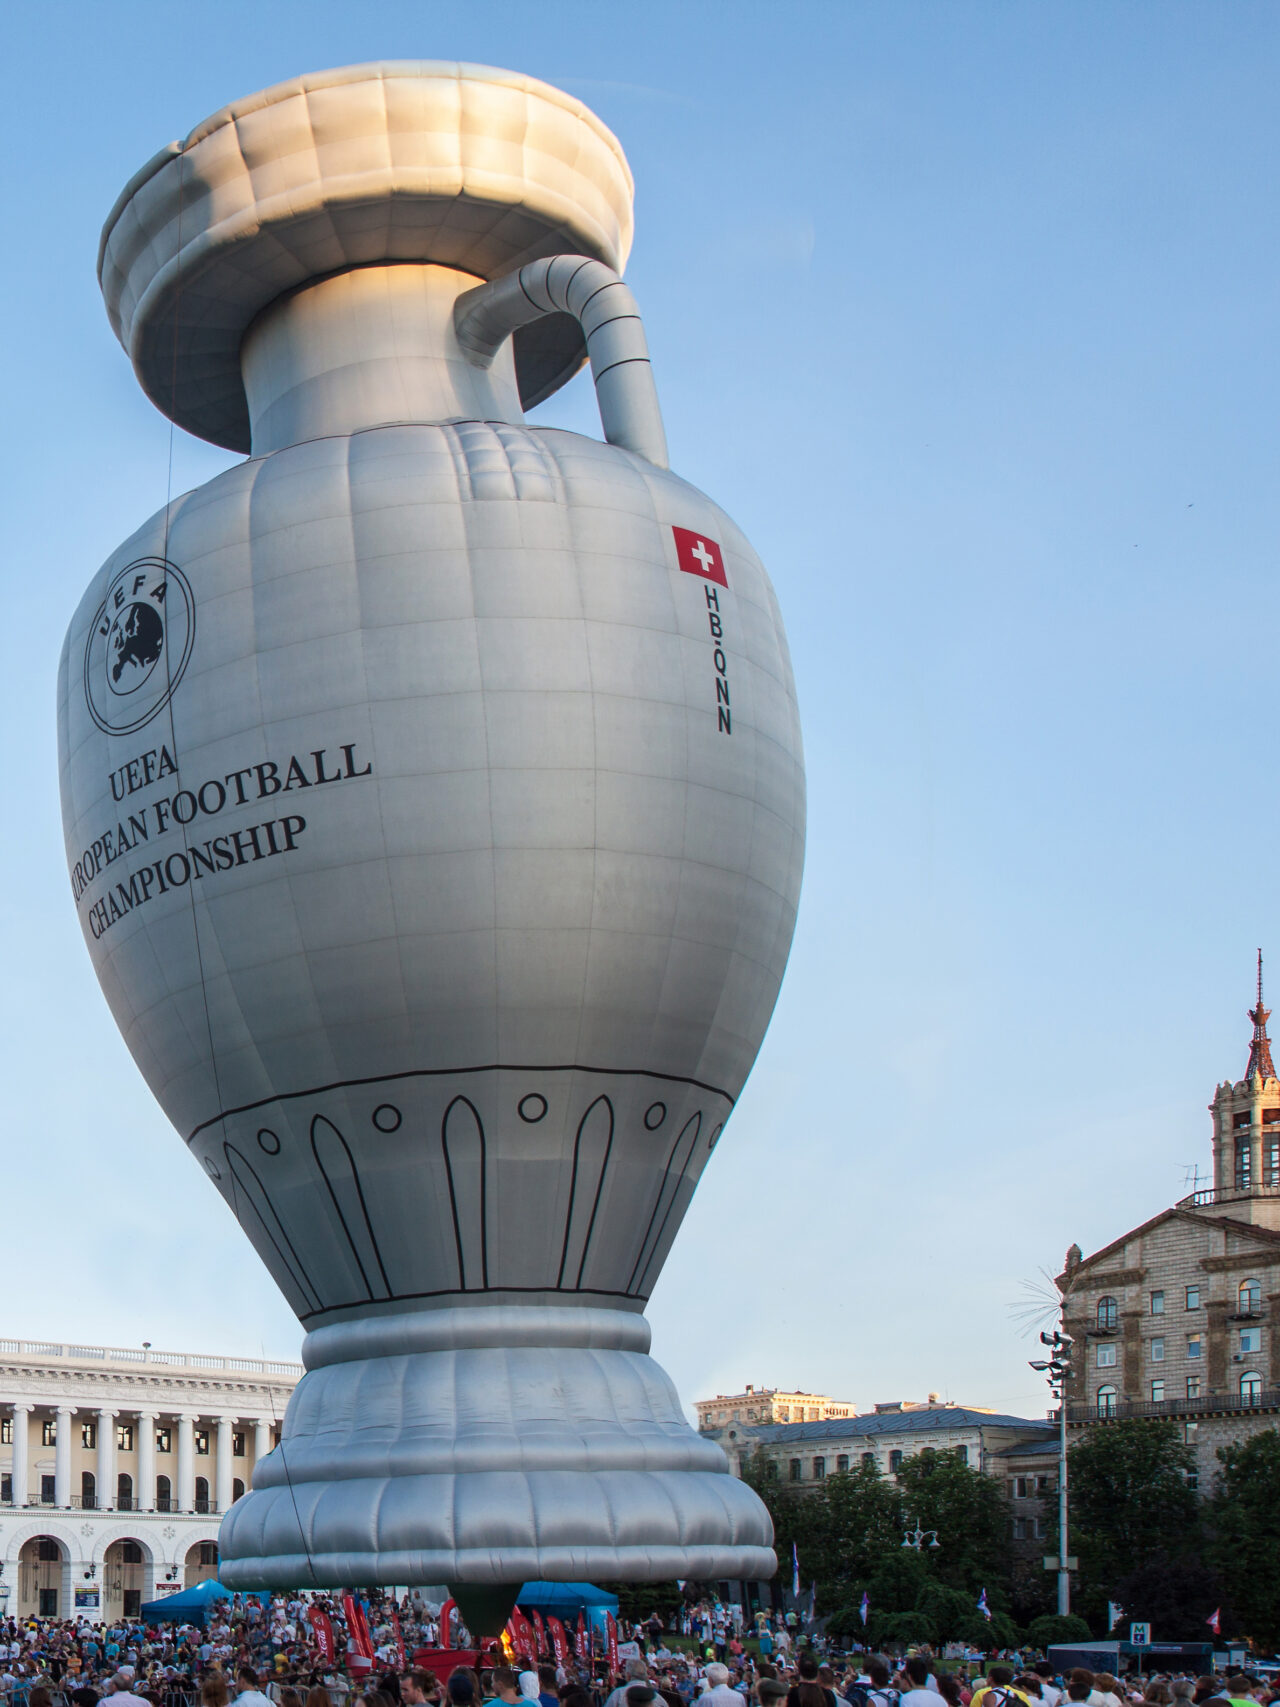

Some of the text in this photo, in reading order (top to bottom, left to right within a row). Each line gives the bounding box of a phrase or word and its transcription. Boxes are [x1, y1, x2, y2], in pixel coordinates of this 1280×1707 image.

[99, 574, 168, 637] UEFA
[109, 744, 179, 801] UEFA
[71, 743, 372, 904] UROPEAN FOOTBALL
[88, 815, 306, 940] CHAMPIONSHIP
